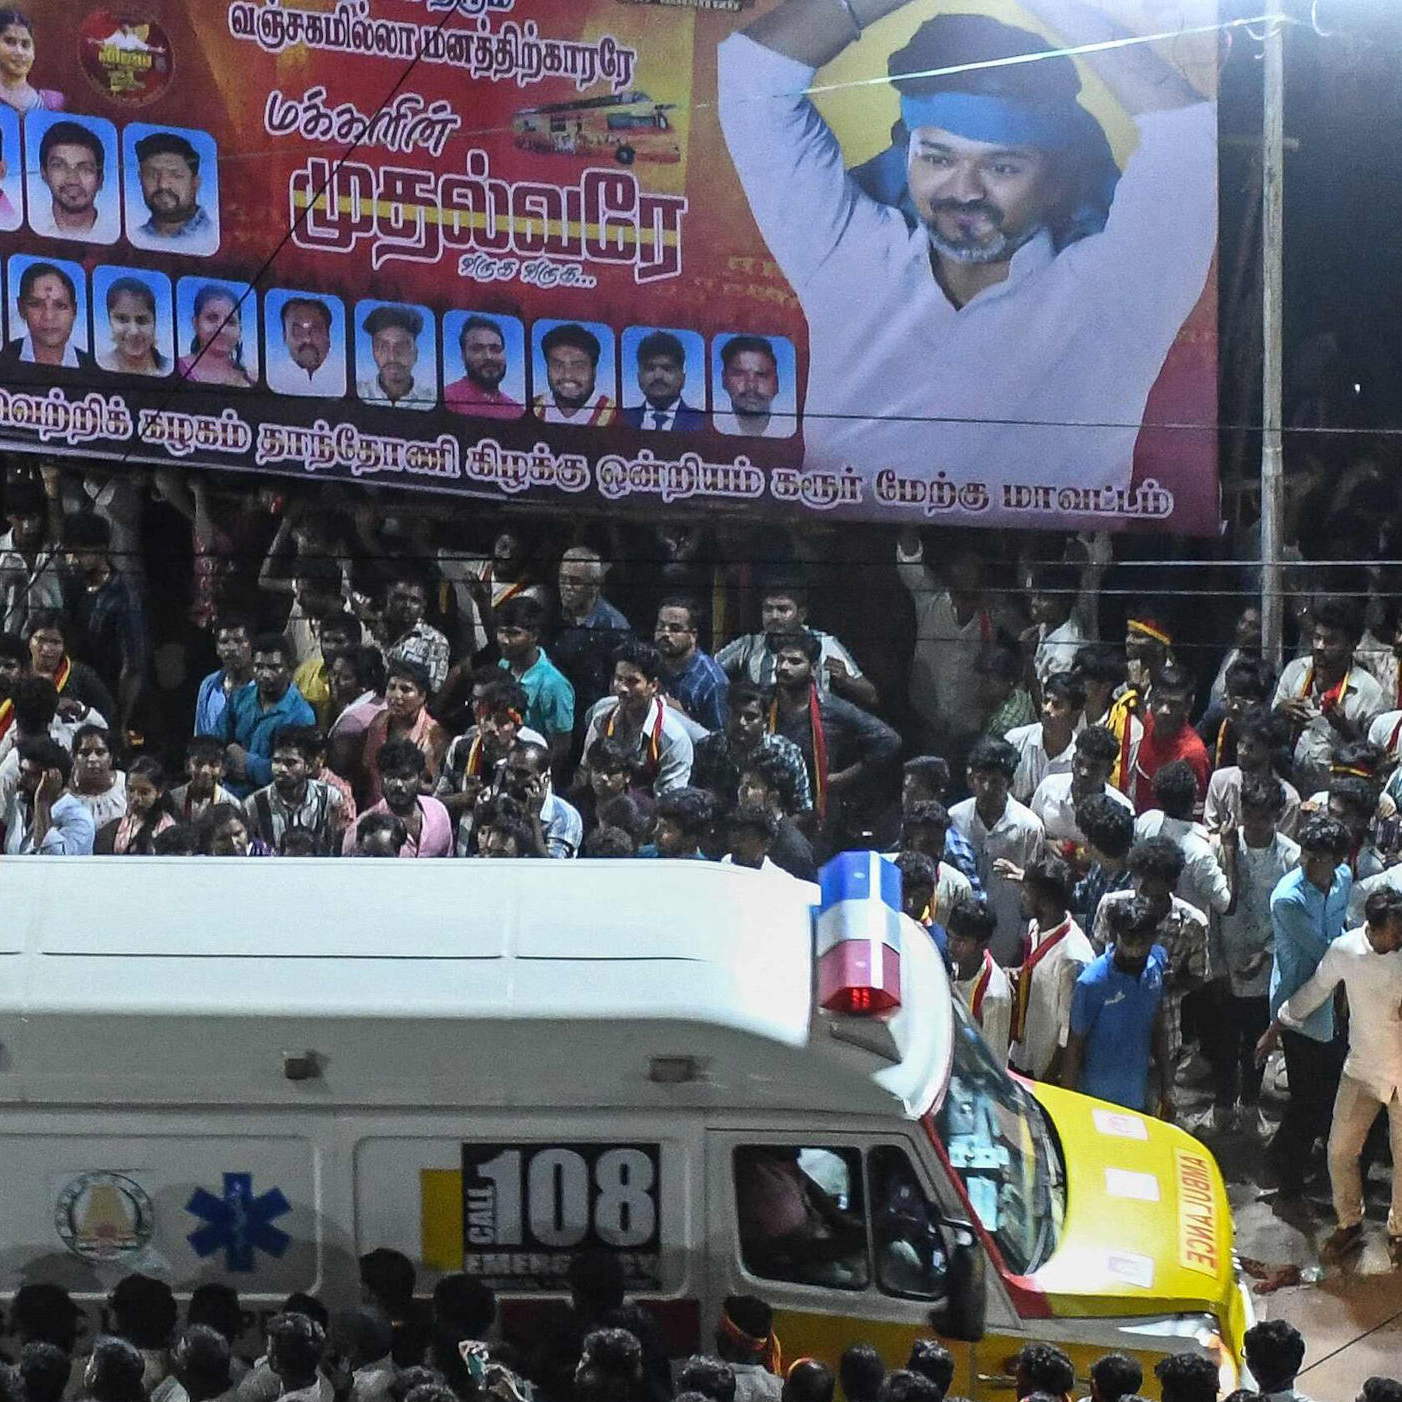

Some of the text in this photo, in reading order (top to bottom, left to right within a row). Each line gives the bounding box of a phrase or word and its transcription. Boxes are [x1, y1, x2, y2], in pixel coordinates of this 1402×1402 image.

[289, 149, 688, 284] முதல்வரே
[139, 408, 251, 456] கழகம்
[466, 438, 589, 491] கிழக்கு
[597, 449, 766, 502] ஒன்றியம்
[771, 466, 863, 510] கரூர்
[874, 468, 990, 517] மேற்கு
[1002, 478, 1174, 519] மாவட்டம்
[467, 1185, 494, 1244] CALL
[477, 1148, 656, 1247] 108
[465, 1253, 658, 1276] EMERGCY
